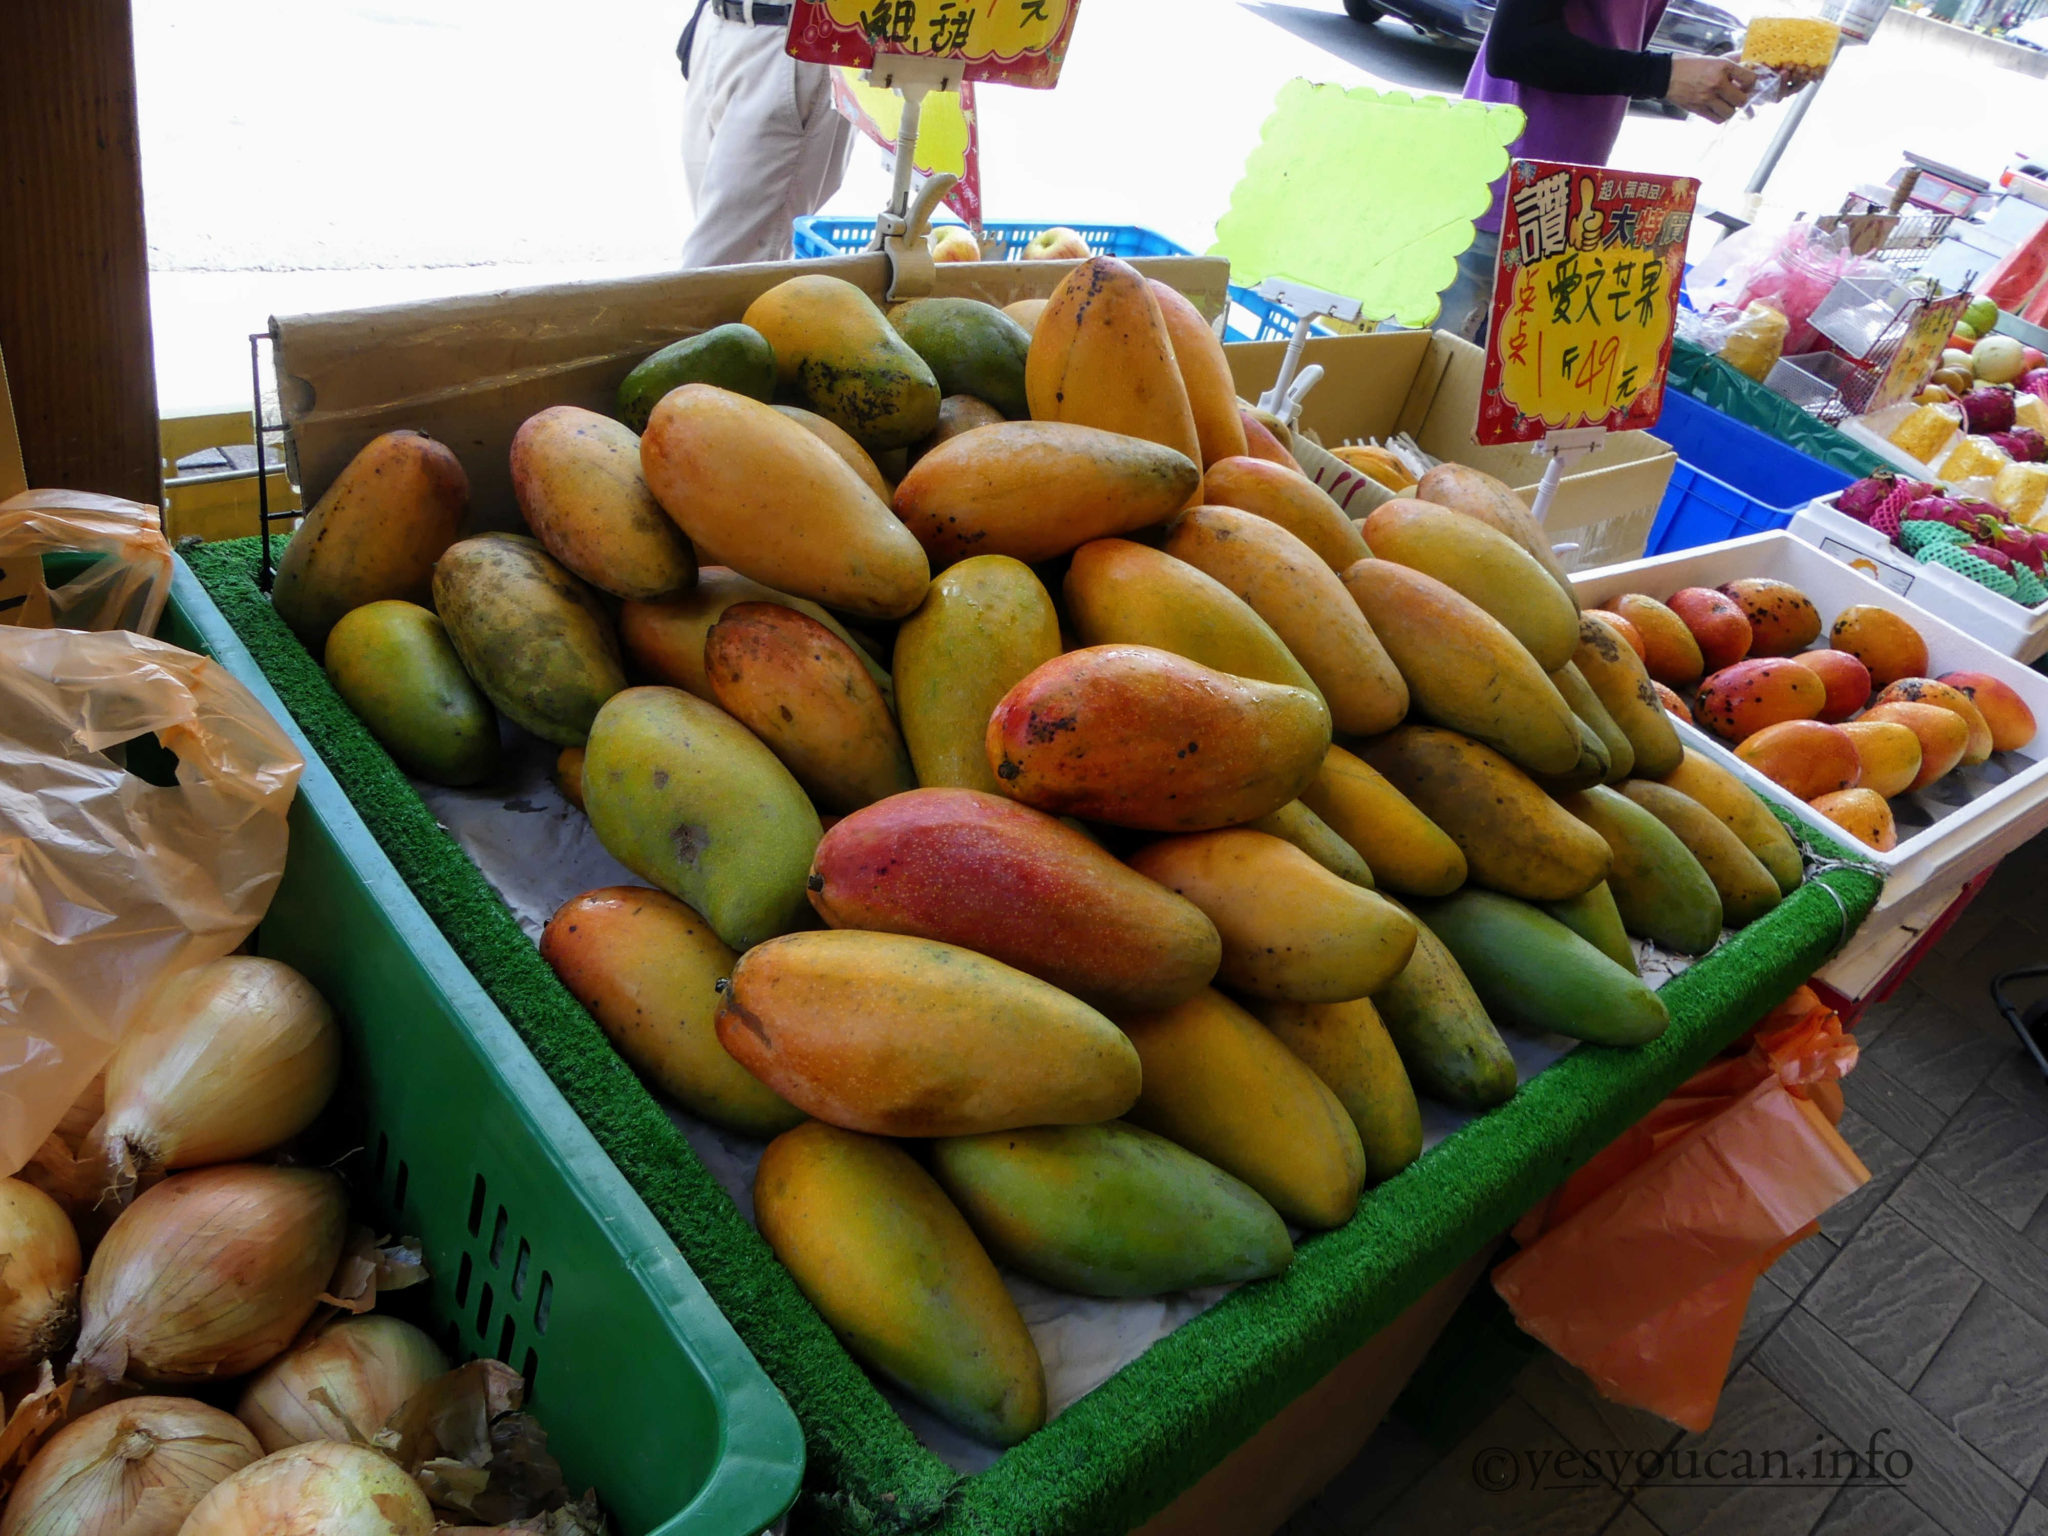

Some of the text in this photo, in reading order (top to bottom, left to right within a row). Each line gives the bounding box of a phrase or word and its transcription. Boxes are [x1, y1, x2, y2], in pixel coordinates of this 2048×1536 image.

[1513, 170, 1572, 267] 讚
[1602, 202, 1692, 252] 大特價
